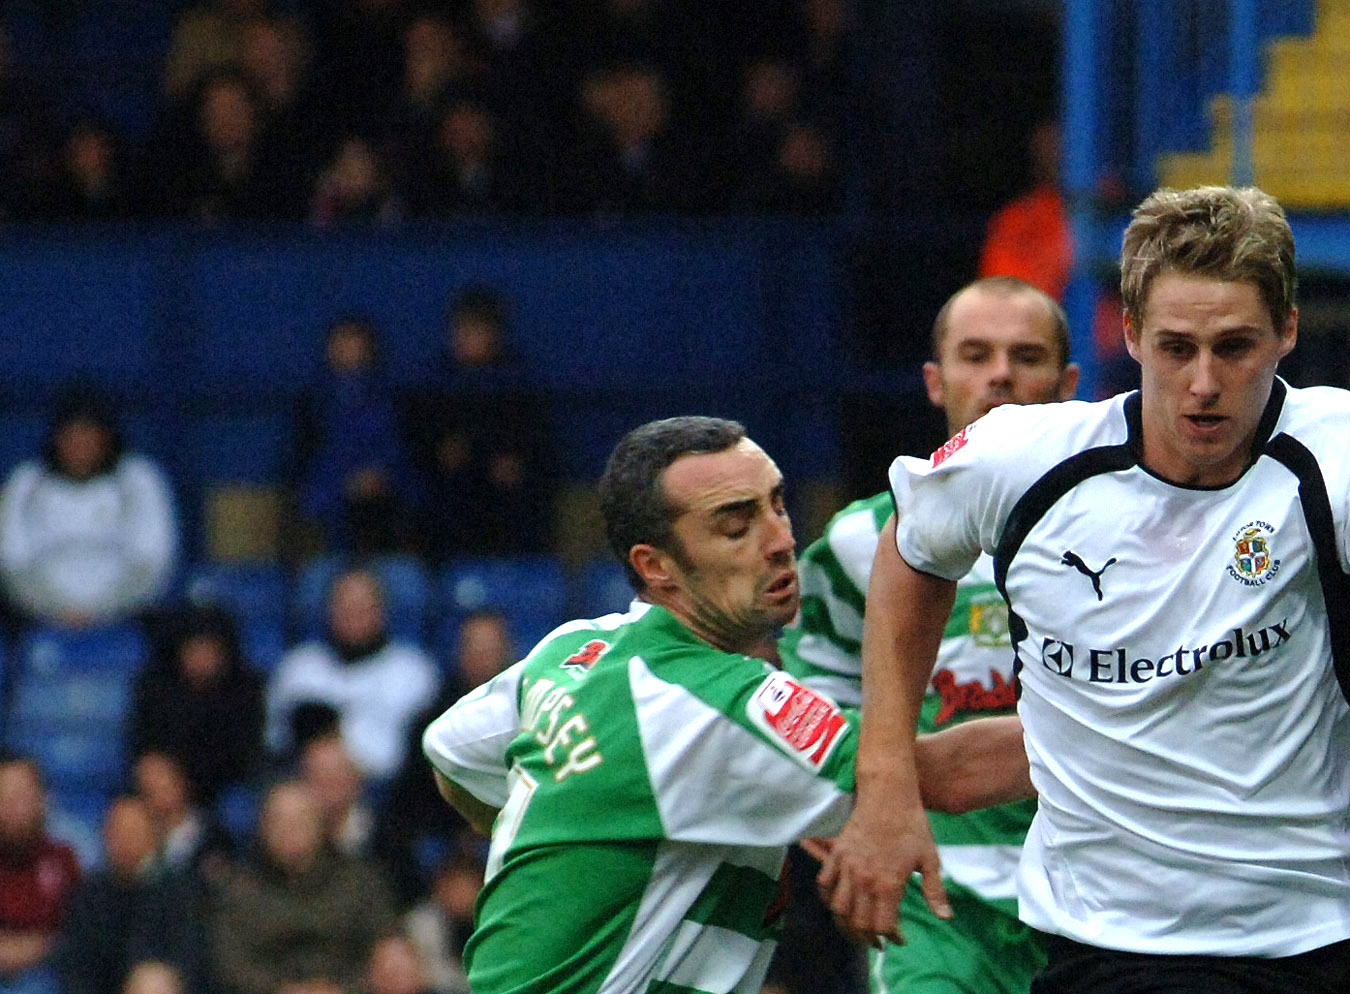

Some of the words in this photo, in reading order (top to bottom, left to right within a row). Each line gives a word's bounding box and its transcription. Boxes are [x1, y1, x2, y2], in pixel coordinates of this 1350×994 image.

[1226, 564, 1265, 587] FOOTBALL
[1265, 559, 1281, 581] CLUB
[1089, 617, 1293, 684] Electrolux
